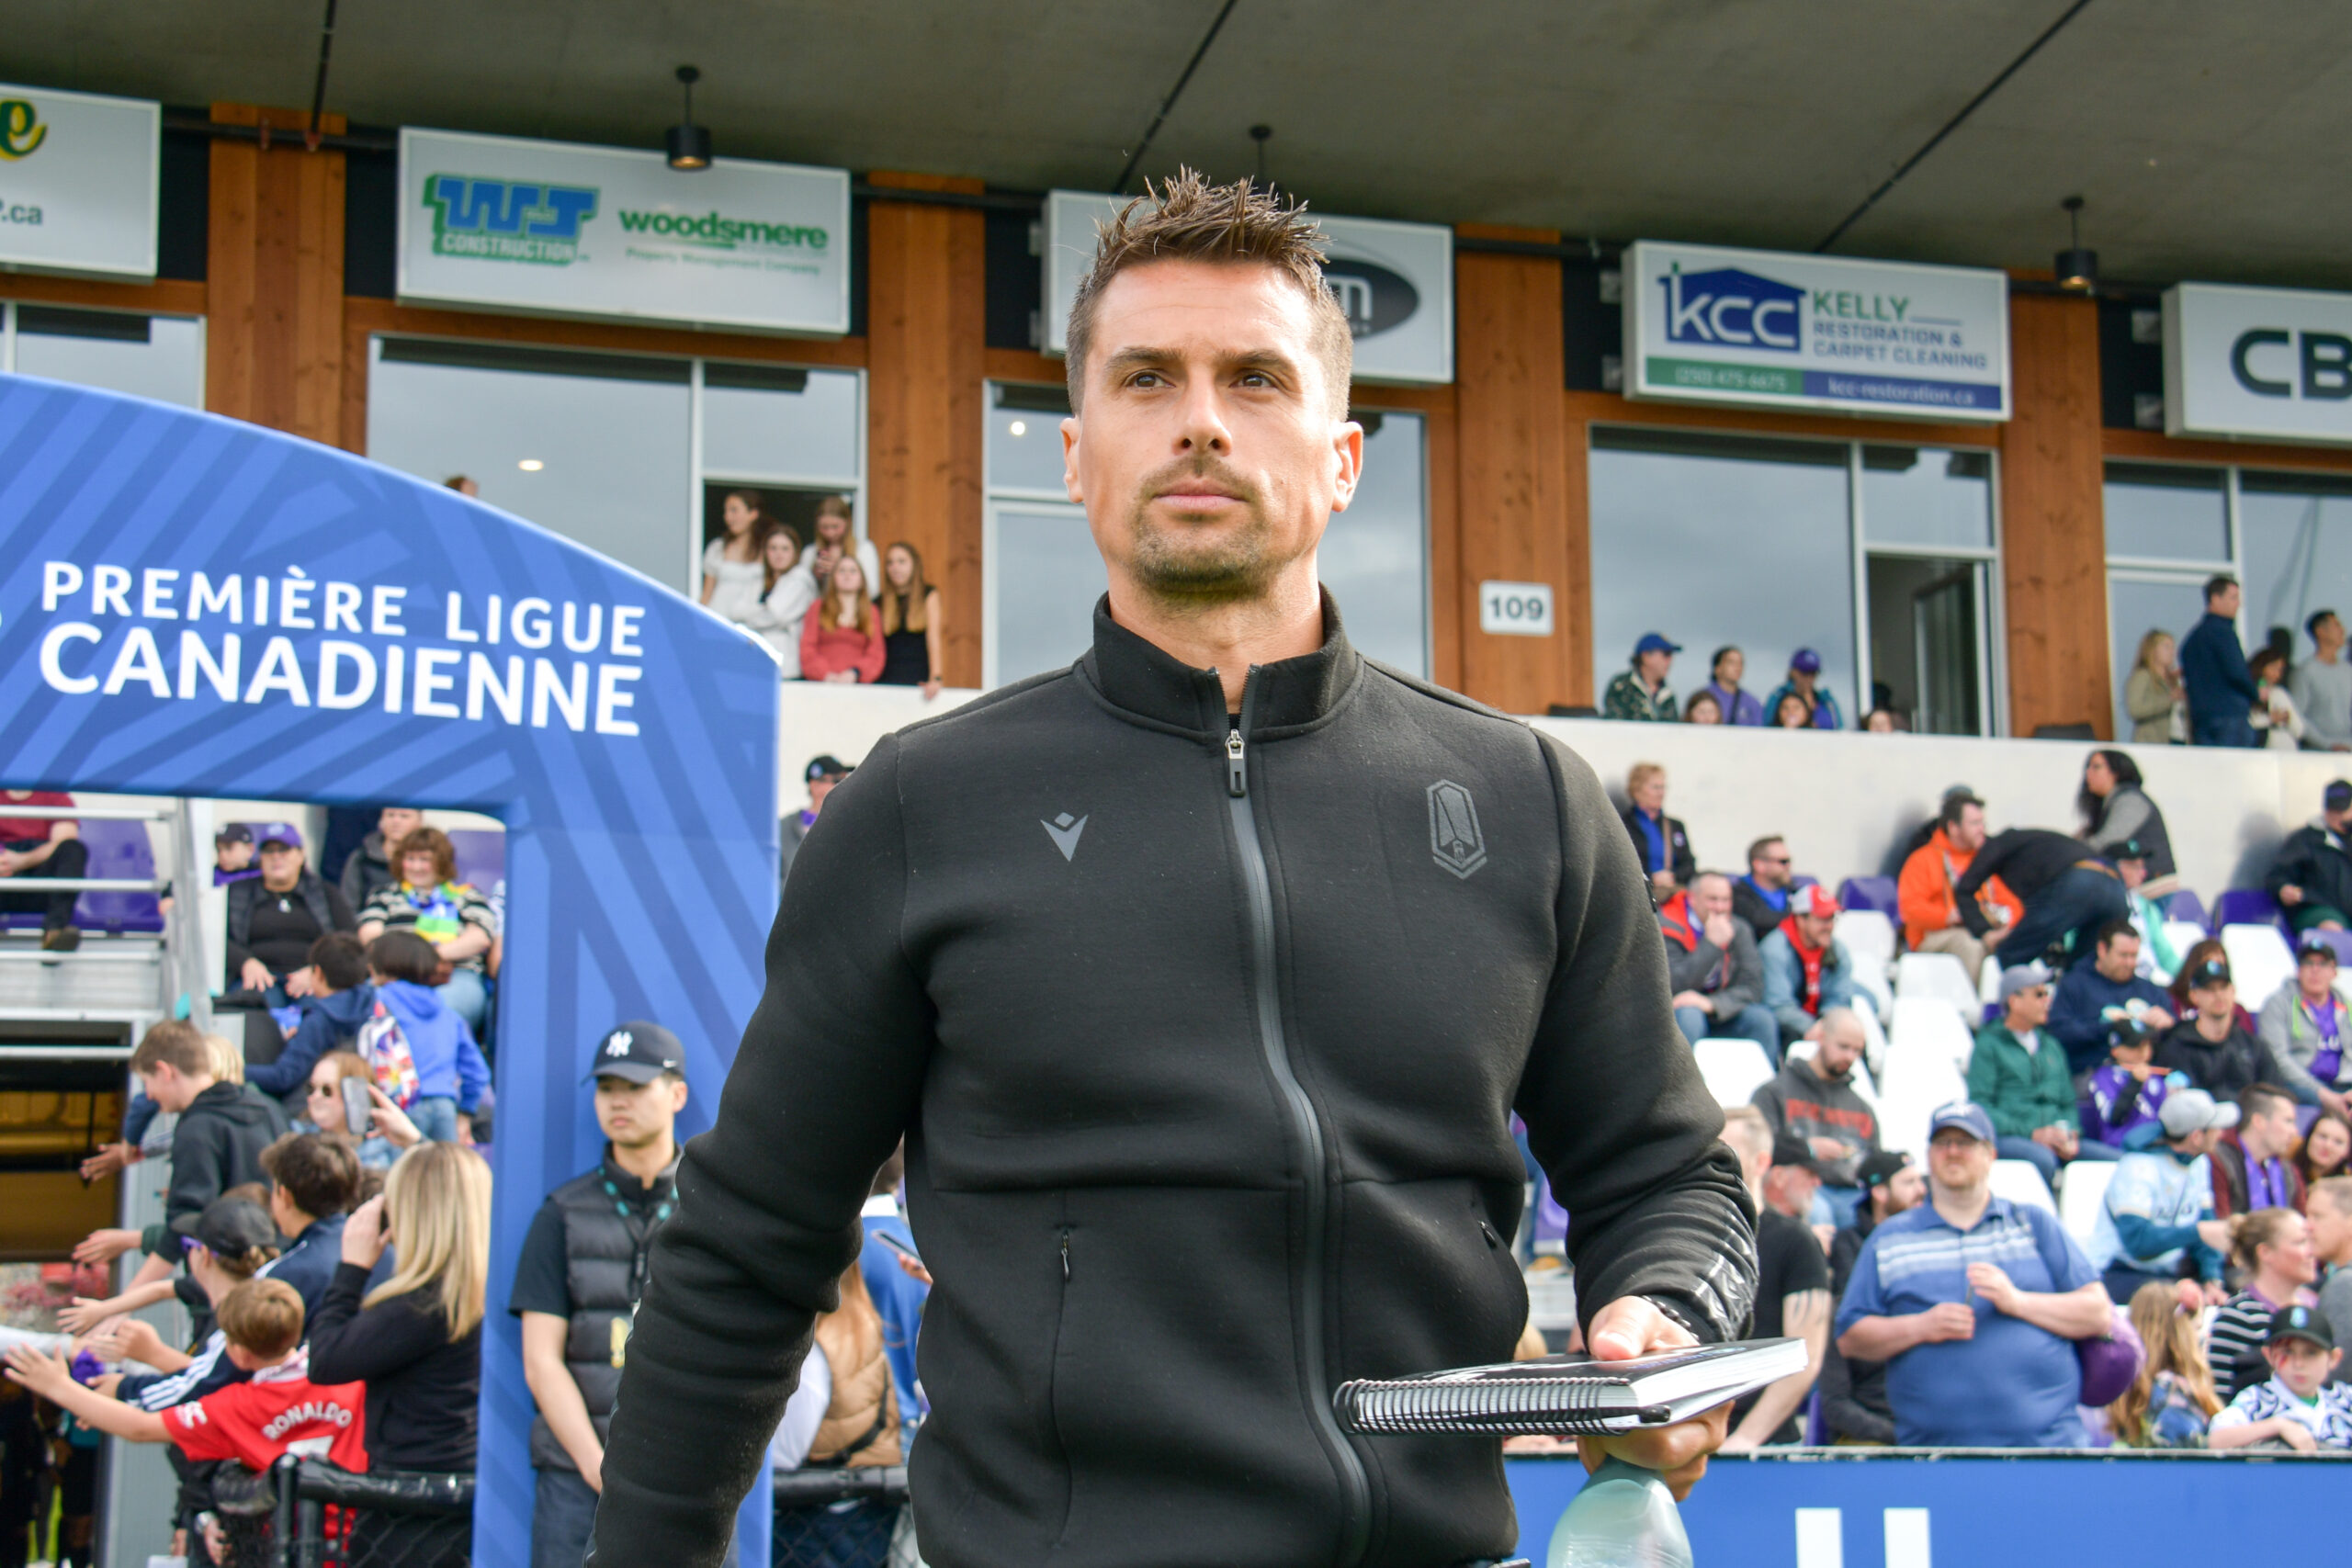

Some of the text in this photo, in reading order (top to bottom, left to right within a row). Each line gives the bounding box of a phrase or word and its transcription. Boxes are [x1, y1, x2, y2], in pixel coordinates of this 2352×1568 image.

[619, 210, 829, 250] woodsmere
[443, 232, 577, 262] CONSTRUCTION
[1813, 289, 1910, 322] KELLY
[1813, 320, 1963, 348] RESTORATION &
[1813, 339, 1988, 370] CARPET CLEANING
[41, 560, 646, 657] PREMIÈRE LIGUE
[1488, 595, 1544, 622] 109
[39, 620, 643, 737] CANADIENNE
[262, 1401, 353, 1440] RONALDO
